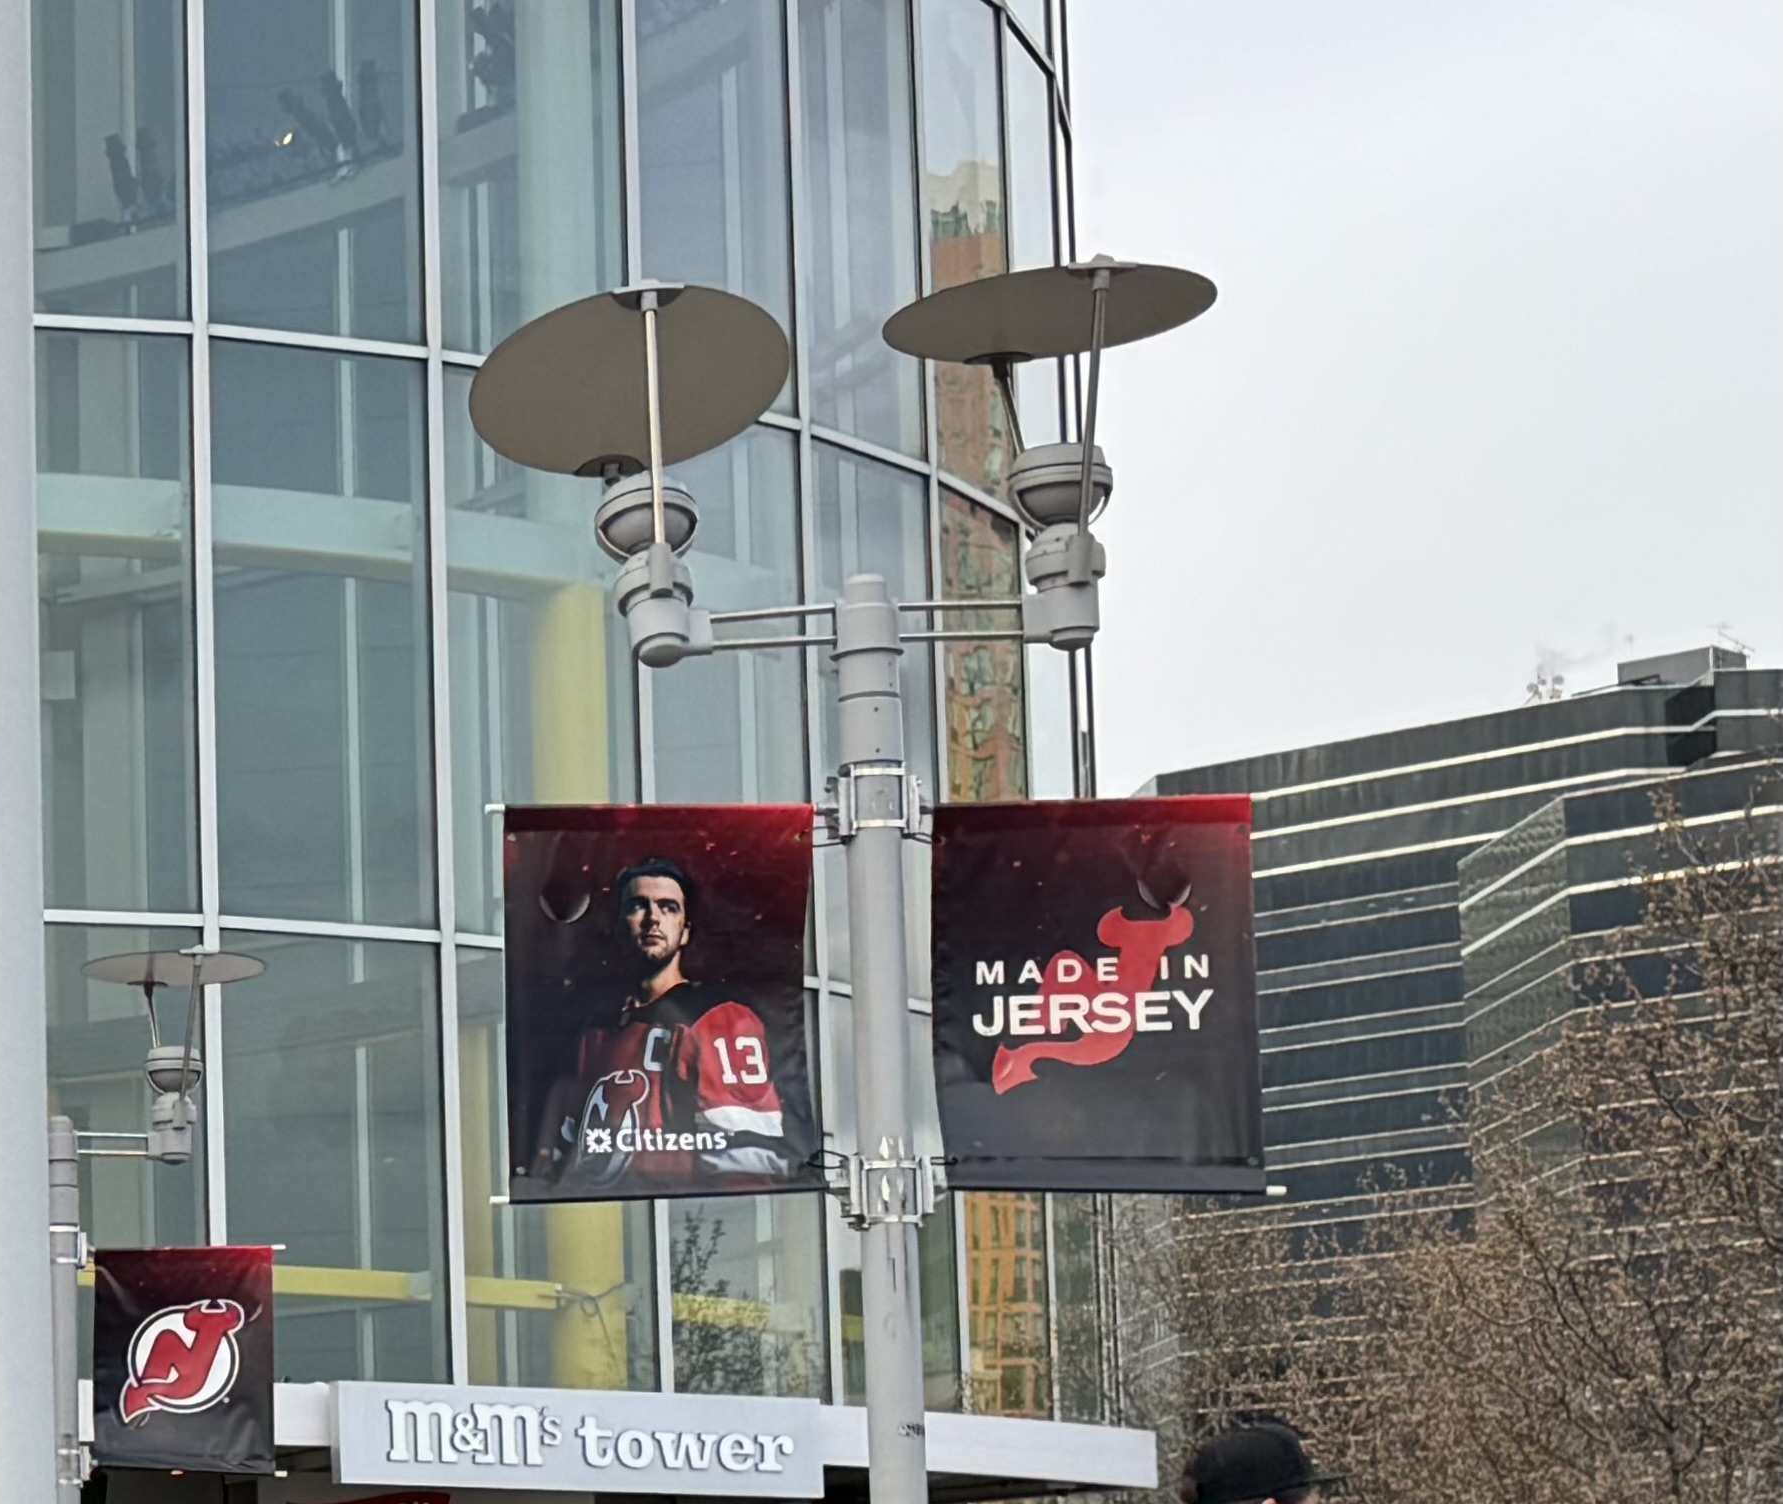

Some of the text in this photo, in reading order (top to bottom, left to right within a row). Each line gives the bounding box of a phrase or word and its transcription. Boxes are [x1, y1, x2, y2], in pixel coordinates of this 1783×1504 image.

[975, 953, 1210, 985] MADE IN
[972, 988, 1215, 1037] JERSEY
[713, 1036, 768, 1084] 13
[615, 1128, 728, 1152] Citizens
[577, 1412, 796, 1473] tower
